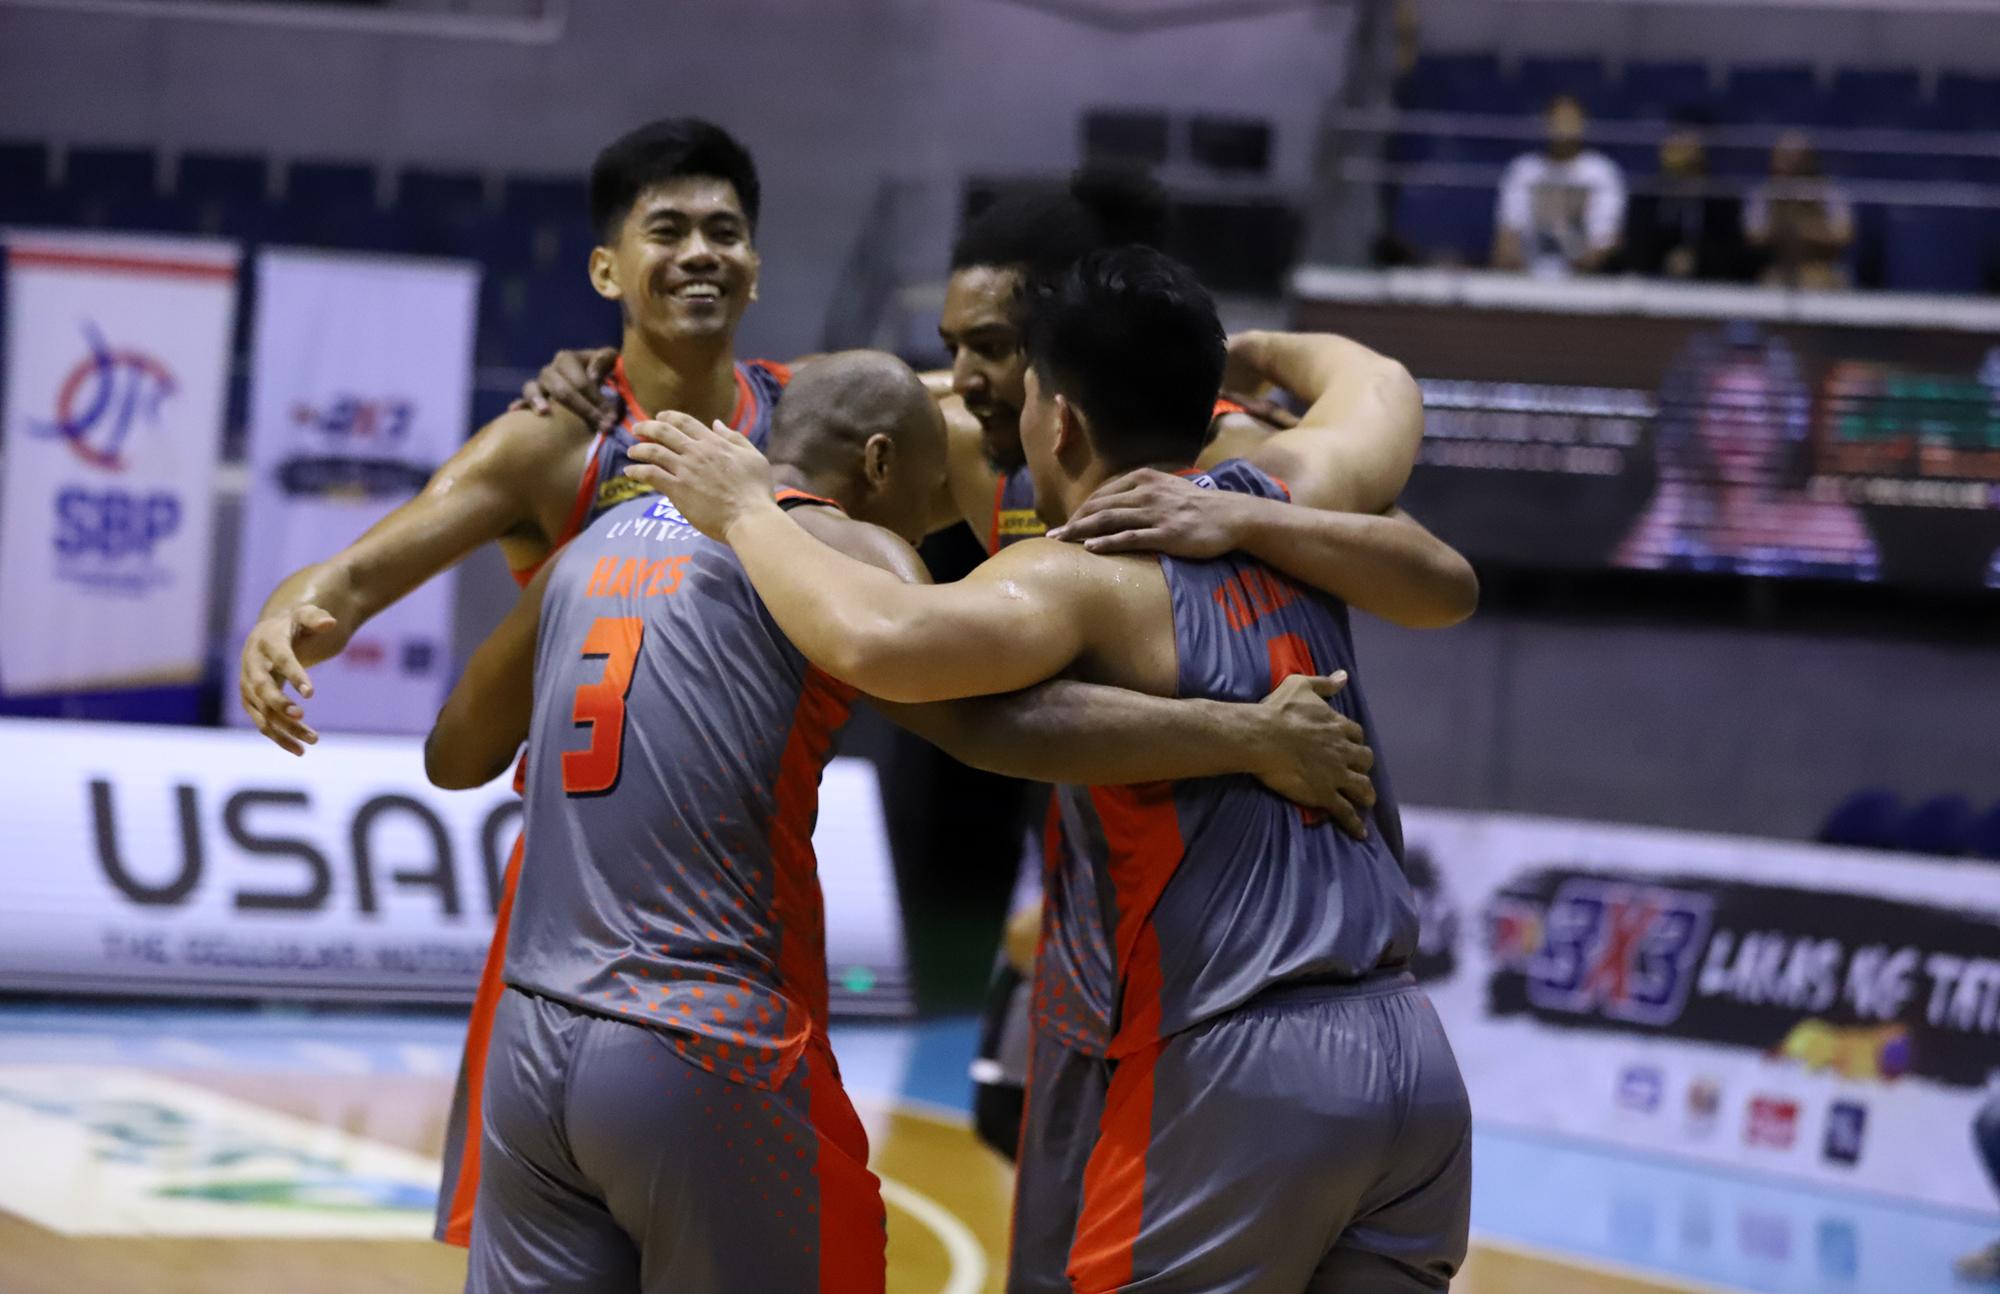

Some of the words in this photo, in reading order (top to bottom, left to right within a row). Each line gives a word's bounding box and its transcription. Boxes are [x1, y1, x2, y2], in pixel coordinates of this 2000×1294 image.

[54, 486, 182, 558] SBP
[585, 555, 692, 600] HAYES
[562, 617, 644, 796] 3
[1535, 890, 1704, 1017] 3X3
[1699, 929, 1842, 1012] LAKAS
[1926, 952, 2000, 1032] TAT
